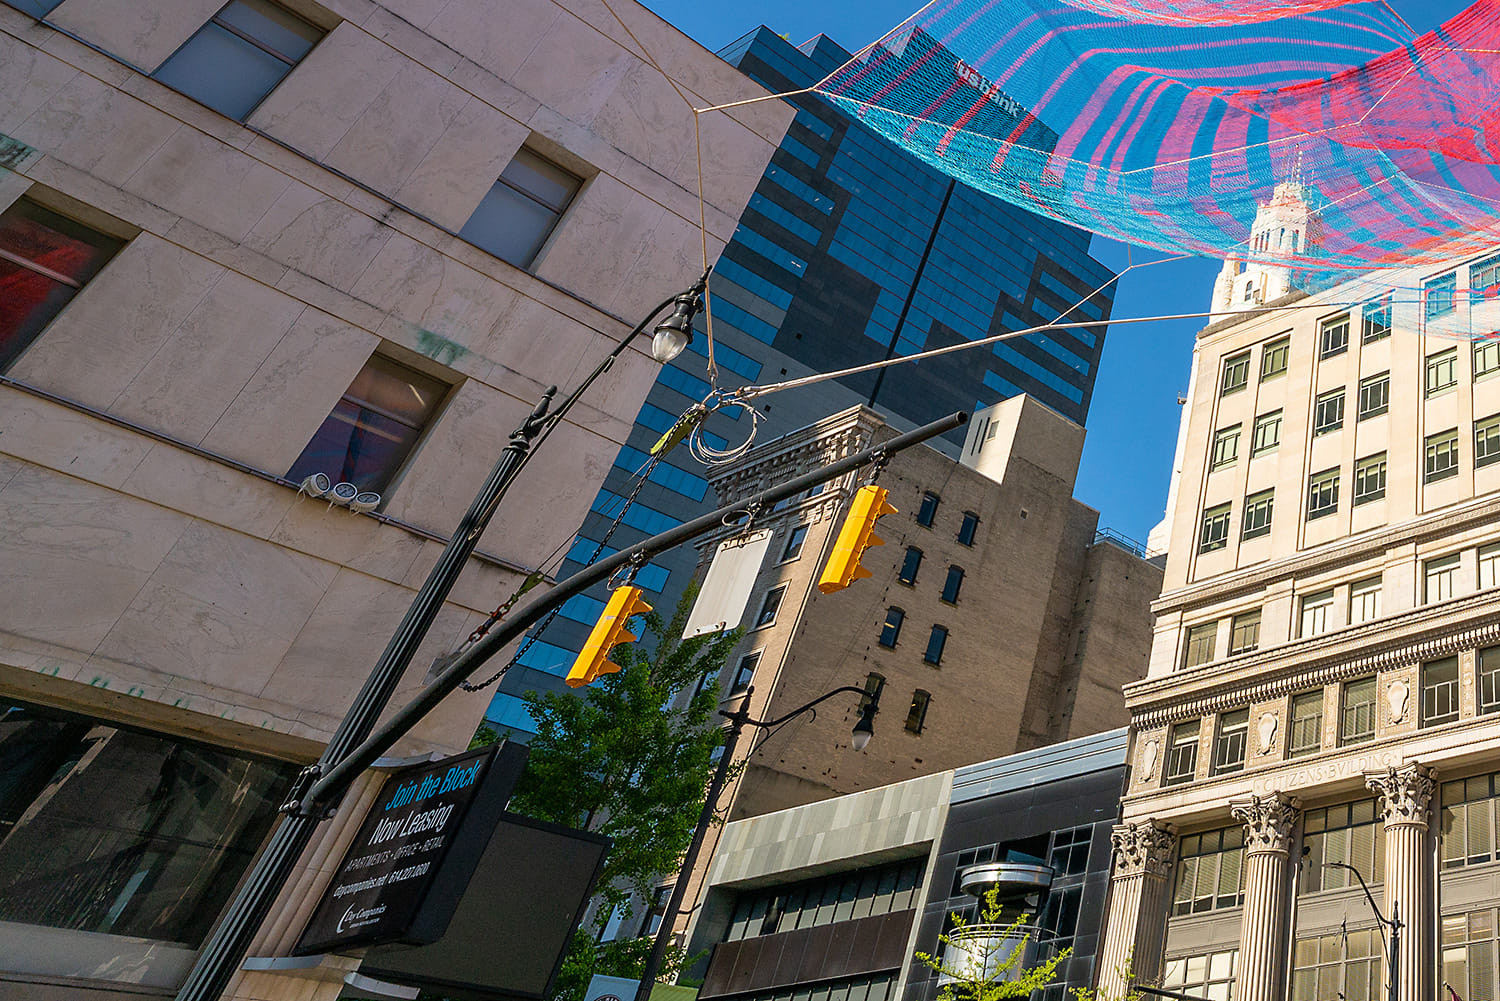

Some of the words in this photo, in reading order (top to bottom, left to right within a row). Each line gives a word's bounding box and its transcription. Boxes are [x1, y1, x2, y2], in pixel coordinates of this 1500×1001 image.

[385, 780, 418, 811] Join
[415, 774, 441, 802] the
[438, 760, 482, 794] Block
[368, 817, 405, 846] Now
[399, 802, 455, 837] Leasing
[344, 850, 392, 873] APARTMENTS
[394, 842, 420, 860] OFFICE
[421, 835, 446, 852] RETAIL
